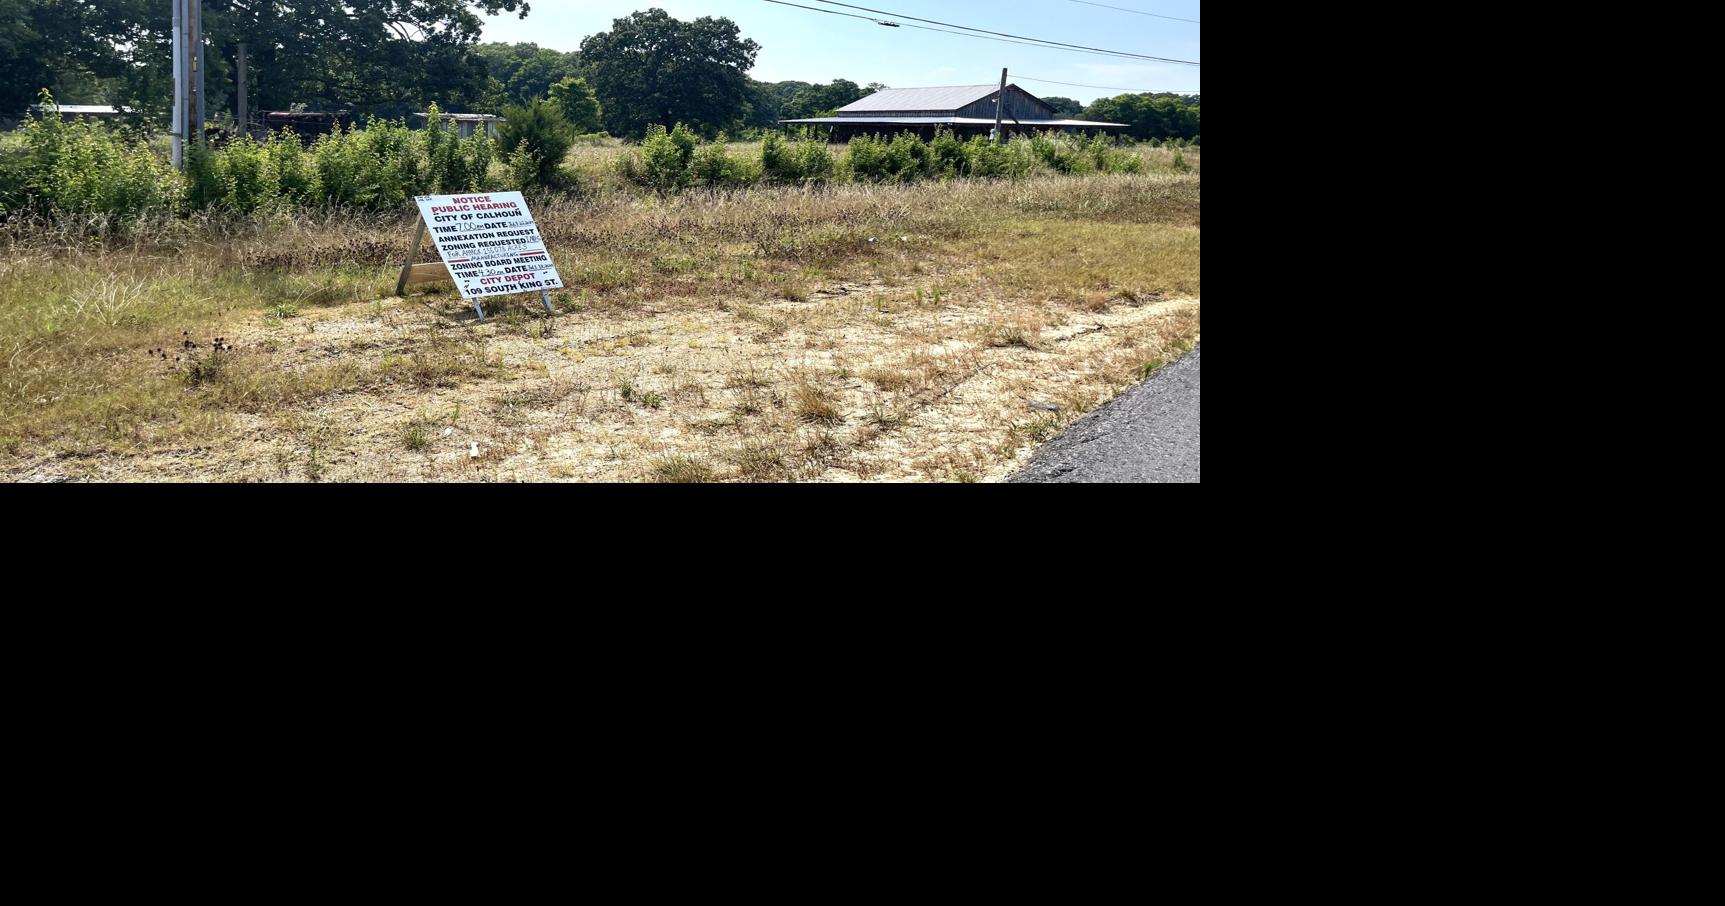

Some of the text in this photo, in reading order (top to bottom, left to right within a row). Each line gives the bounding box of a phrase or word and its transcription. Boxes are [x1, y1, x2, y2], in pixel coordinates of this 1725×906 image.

[452, 196, 491, 204] NOTICE
[431, 201, 517, 213] PUBLIC HEARING
[434, 214, 457, 222] CITY
[476, 210, 522, 219] CALHOUN
[433, 225, 458, 233] TIME
[438, 229, 534, 242] ANNEXATION REQUEST
[441, 242, 476, 251] ZONING
[477, 237, 526, 247] REQUESTED
[450, 255, 547, 270] ZONING BOARD MEETING
[455, 270, 479, 278] TIME
[504, 265, 528, 273] DATE
[480, 273, 535, 285] CITY DEPOT
[465, 287, 482, 295] 109
[485, 283, 517, 293] SOUTH
[519, 281, 543, 289] KING
